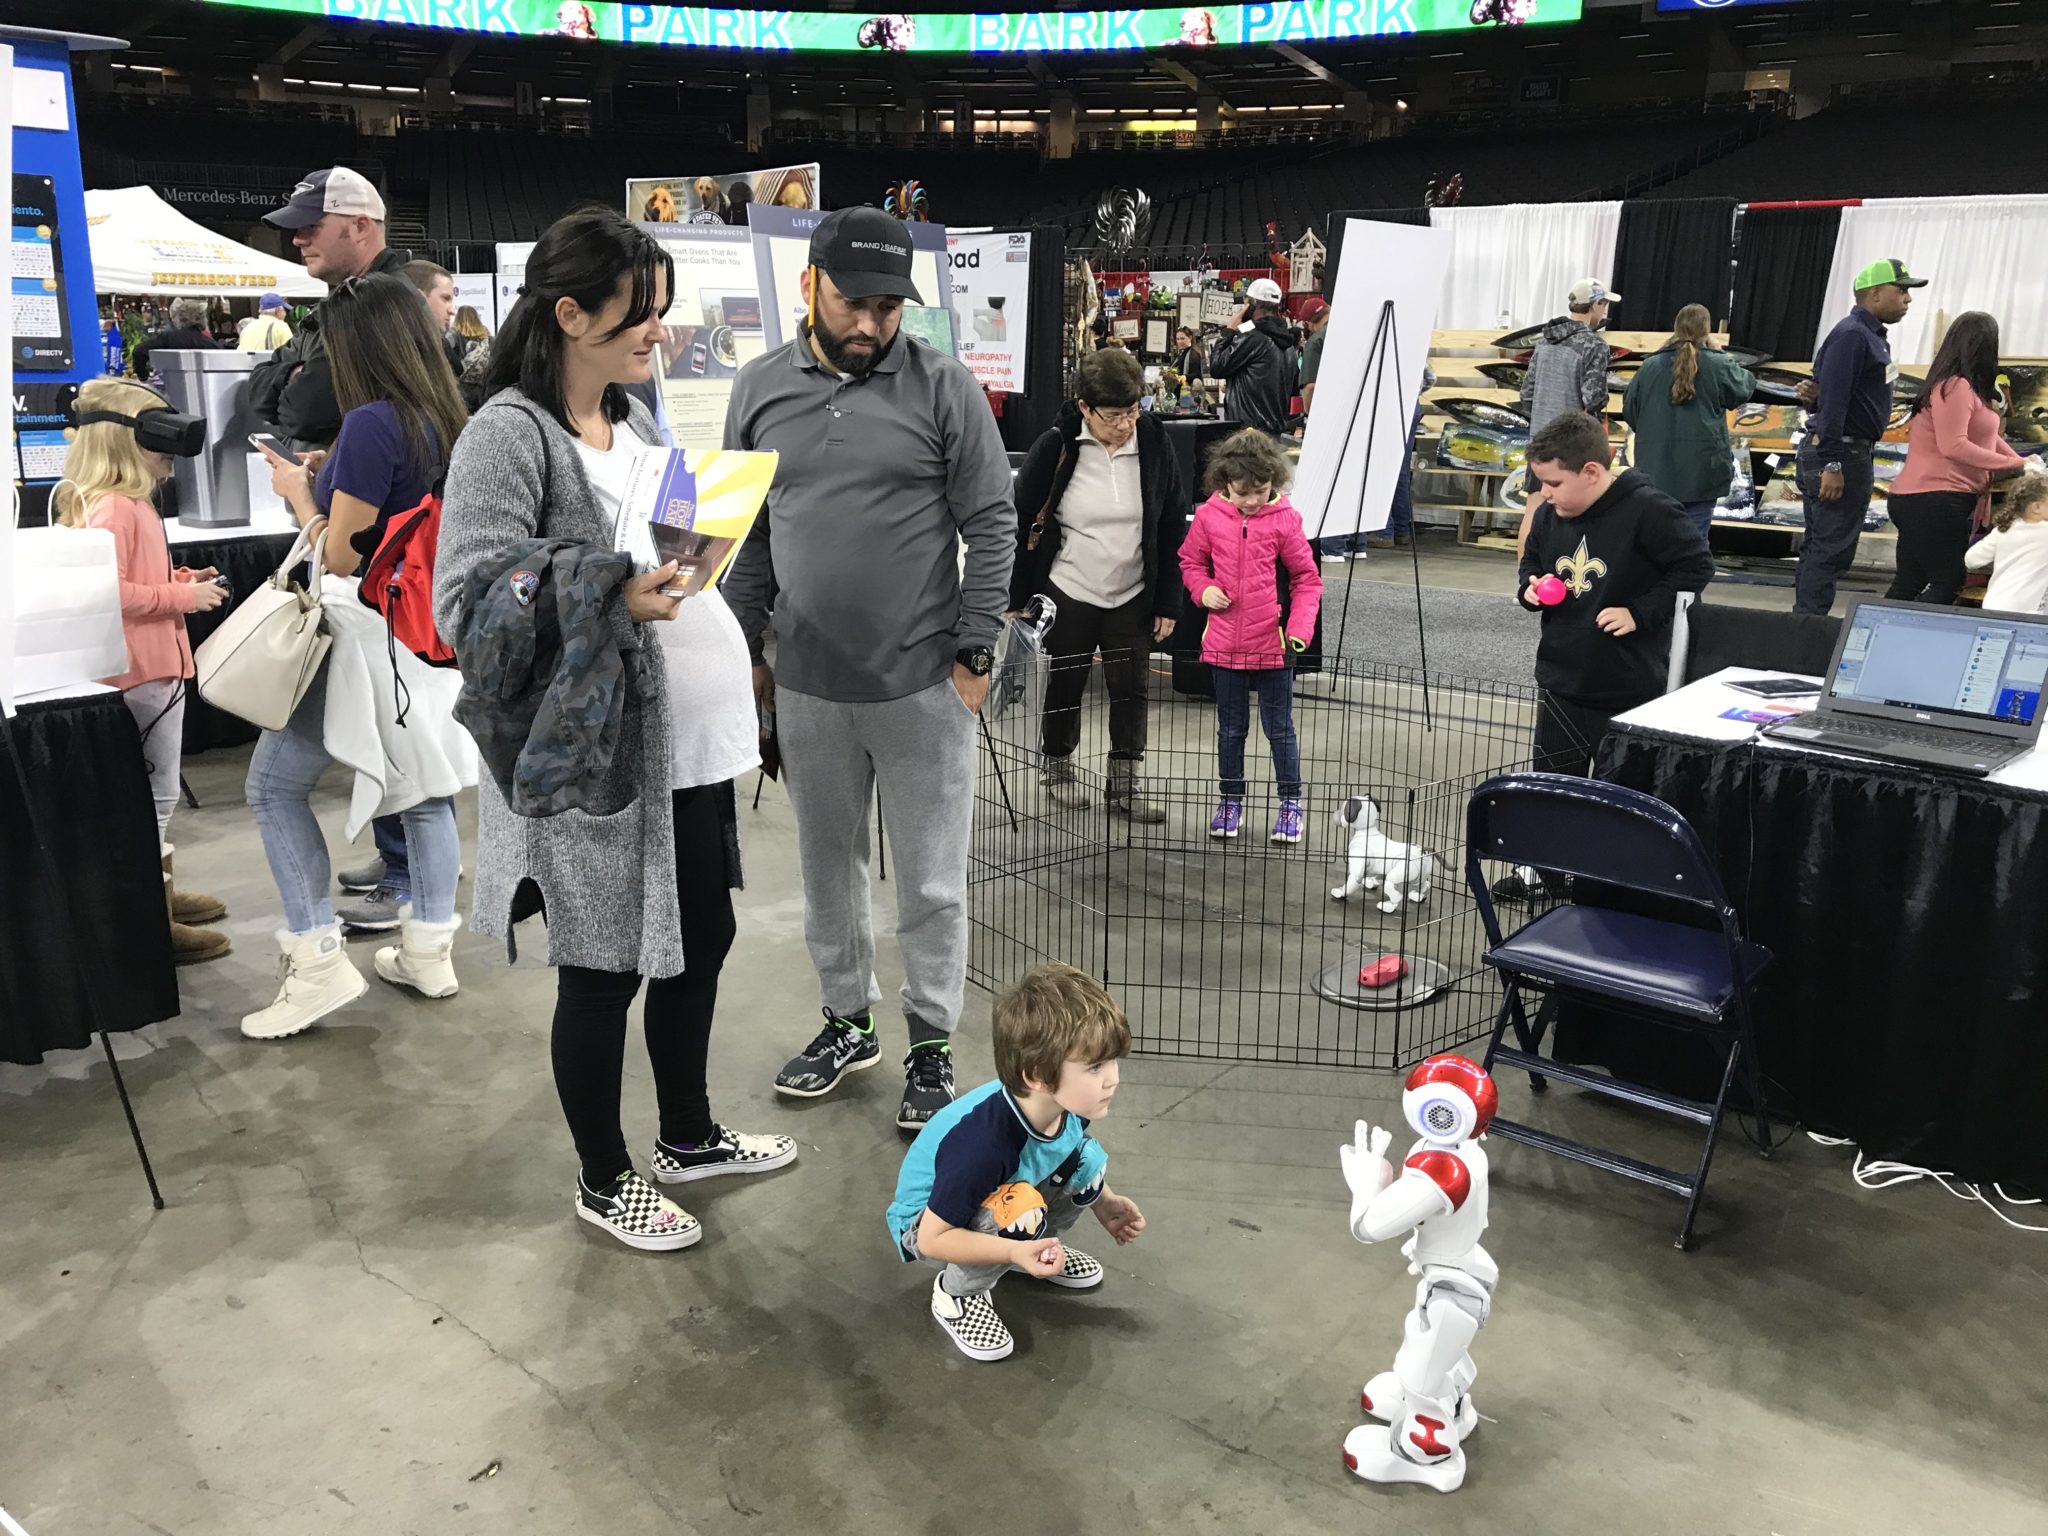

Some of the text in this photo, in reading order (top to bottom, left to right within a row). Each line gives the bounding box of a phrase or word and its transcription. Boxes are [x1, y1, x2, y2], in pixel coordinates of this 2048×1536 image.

[617, 3, 794, 52] PARK
[969, 9, 1146, 54] BARK
[1237, 0, 1418, 47] PARK
[163, 187, 277, 206] Mercedes-Benz
[654, 226, 744, 237] LIFE-CHANGING PRODUCTS
[1009, 235, 1026, 244] FDA
[851, 241, 880, 249] BRAND
[667, 247, 738, 257] Smart Ovens That Are
[689, 257, 710, 265] Cooks
[728, 258, 741, 266] You
[151, 271, 278, 287] JEFFERSON FEED
[1206, 298, 1235, 317] HOPE
[35, 349, 63, 357] DIRECTV
[964, 352, 1012, 362] NEUROPATHY
[996, 366, 1012, 376] PAIN
[621, 501, 634, 532] Schedule
[1915, 712, 1931, 720] DELL
